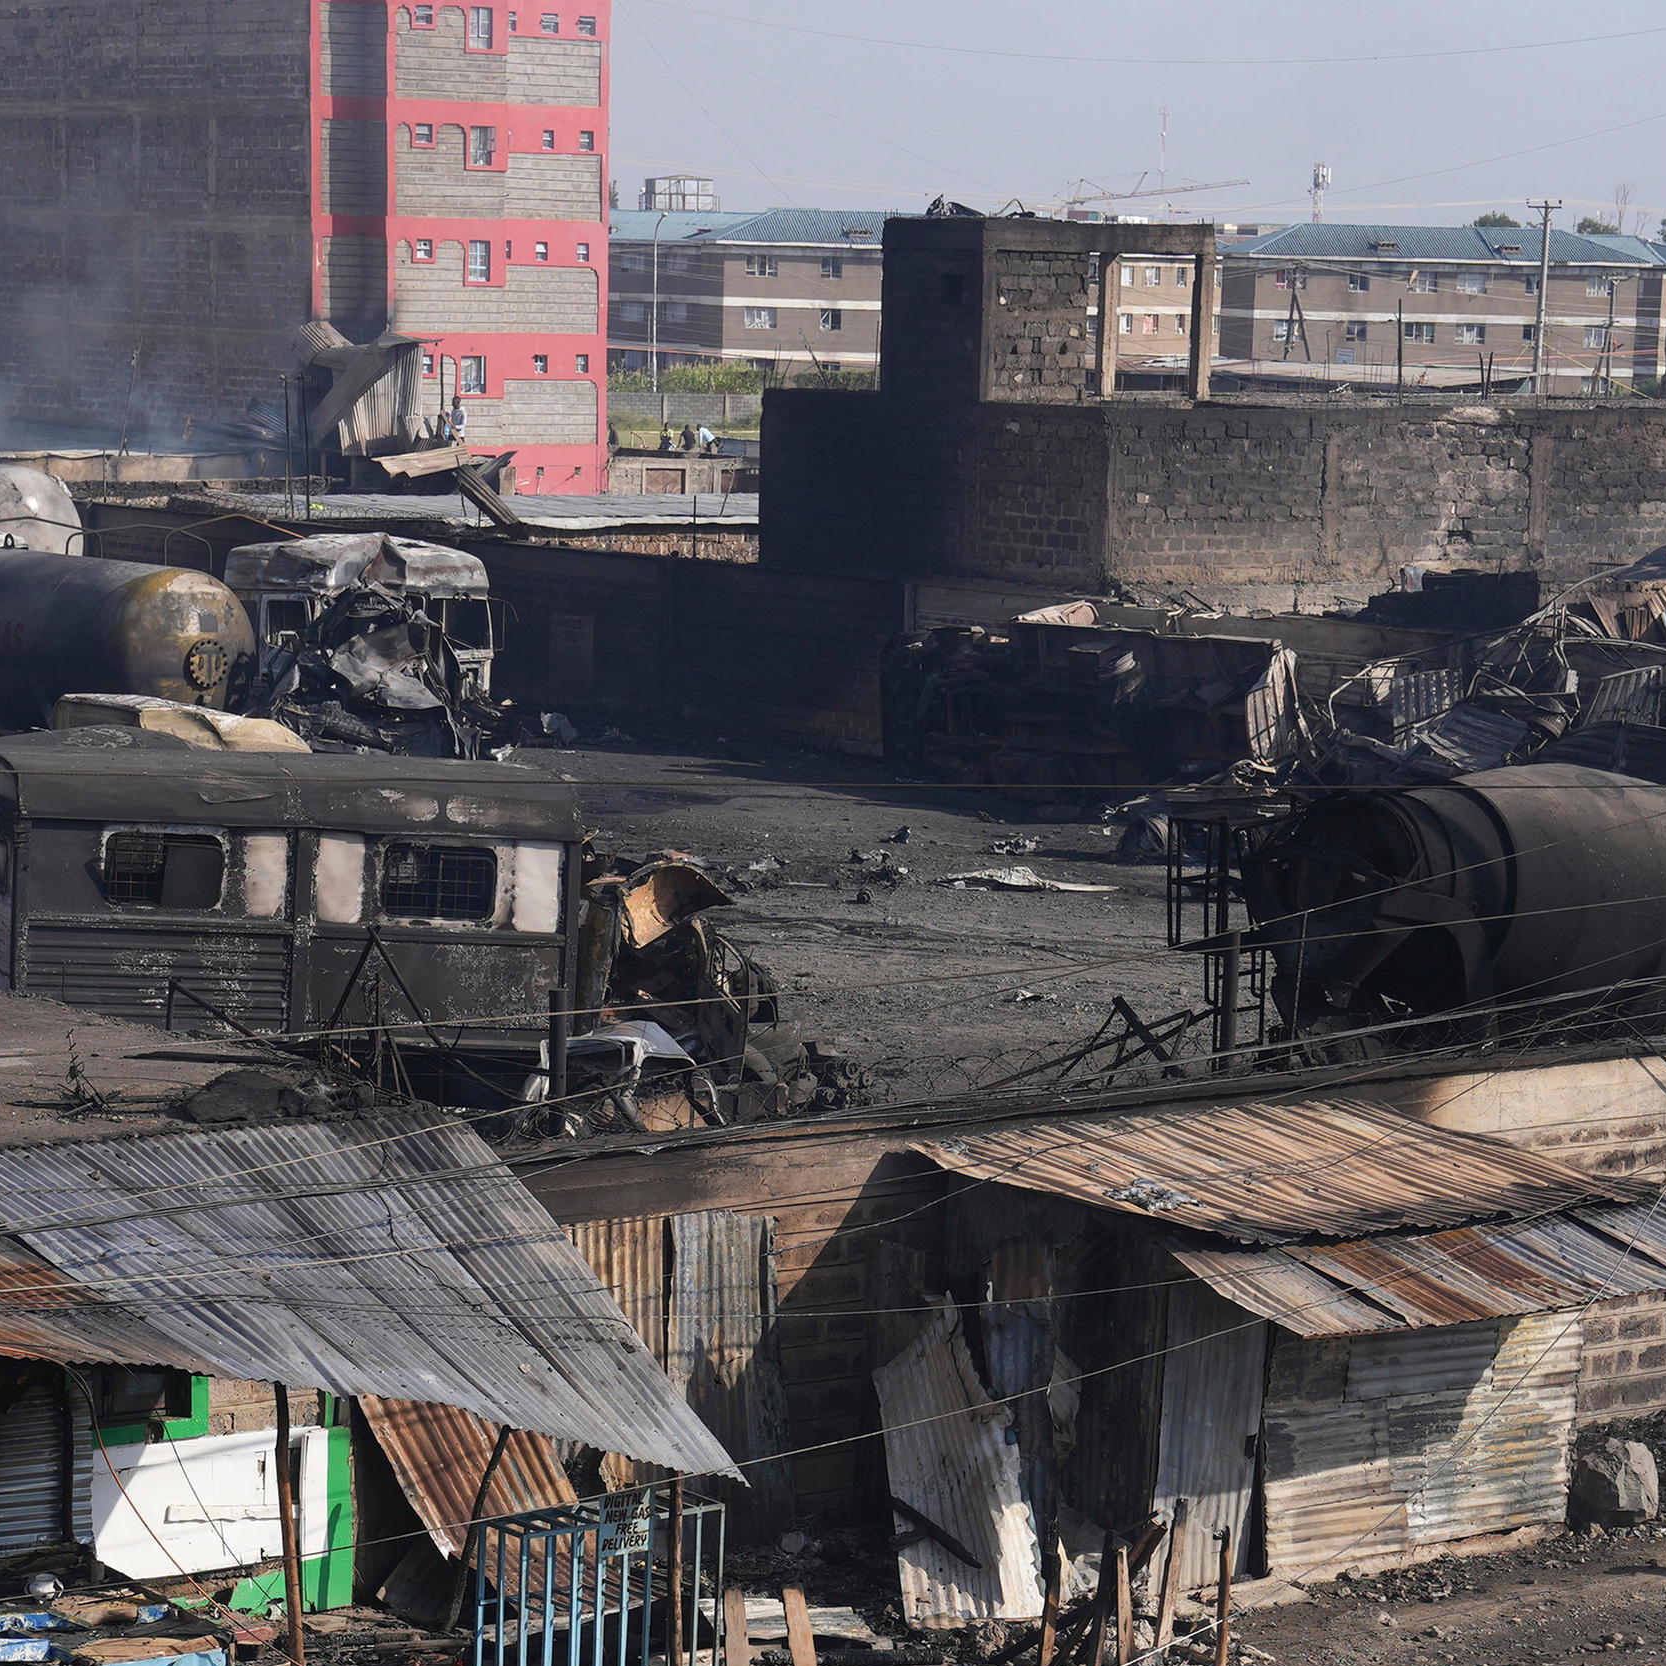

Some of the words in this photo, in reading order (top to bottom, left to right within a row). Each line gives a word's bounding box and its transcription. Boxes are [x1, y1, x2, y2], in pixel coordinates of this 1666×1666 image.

[604, 1493, 644, 1510] DIGITAL
[605, 1507, 627, 1524] NEW
[631, 1506, 651, 1521] GAS
[616, 1522, 639, 1536] FREE
[602, 1534, 647, 1552] DELIVERY
